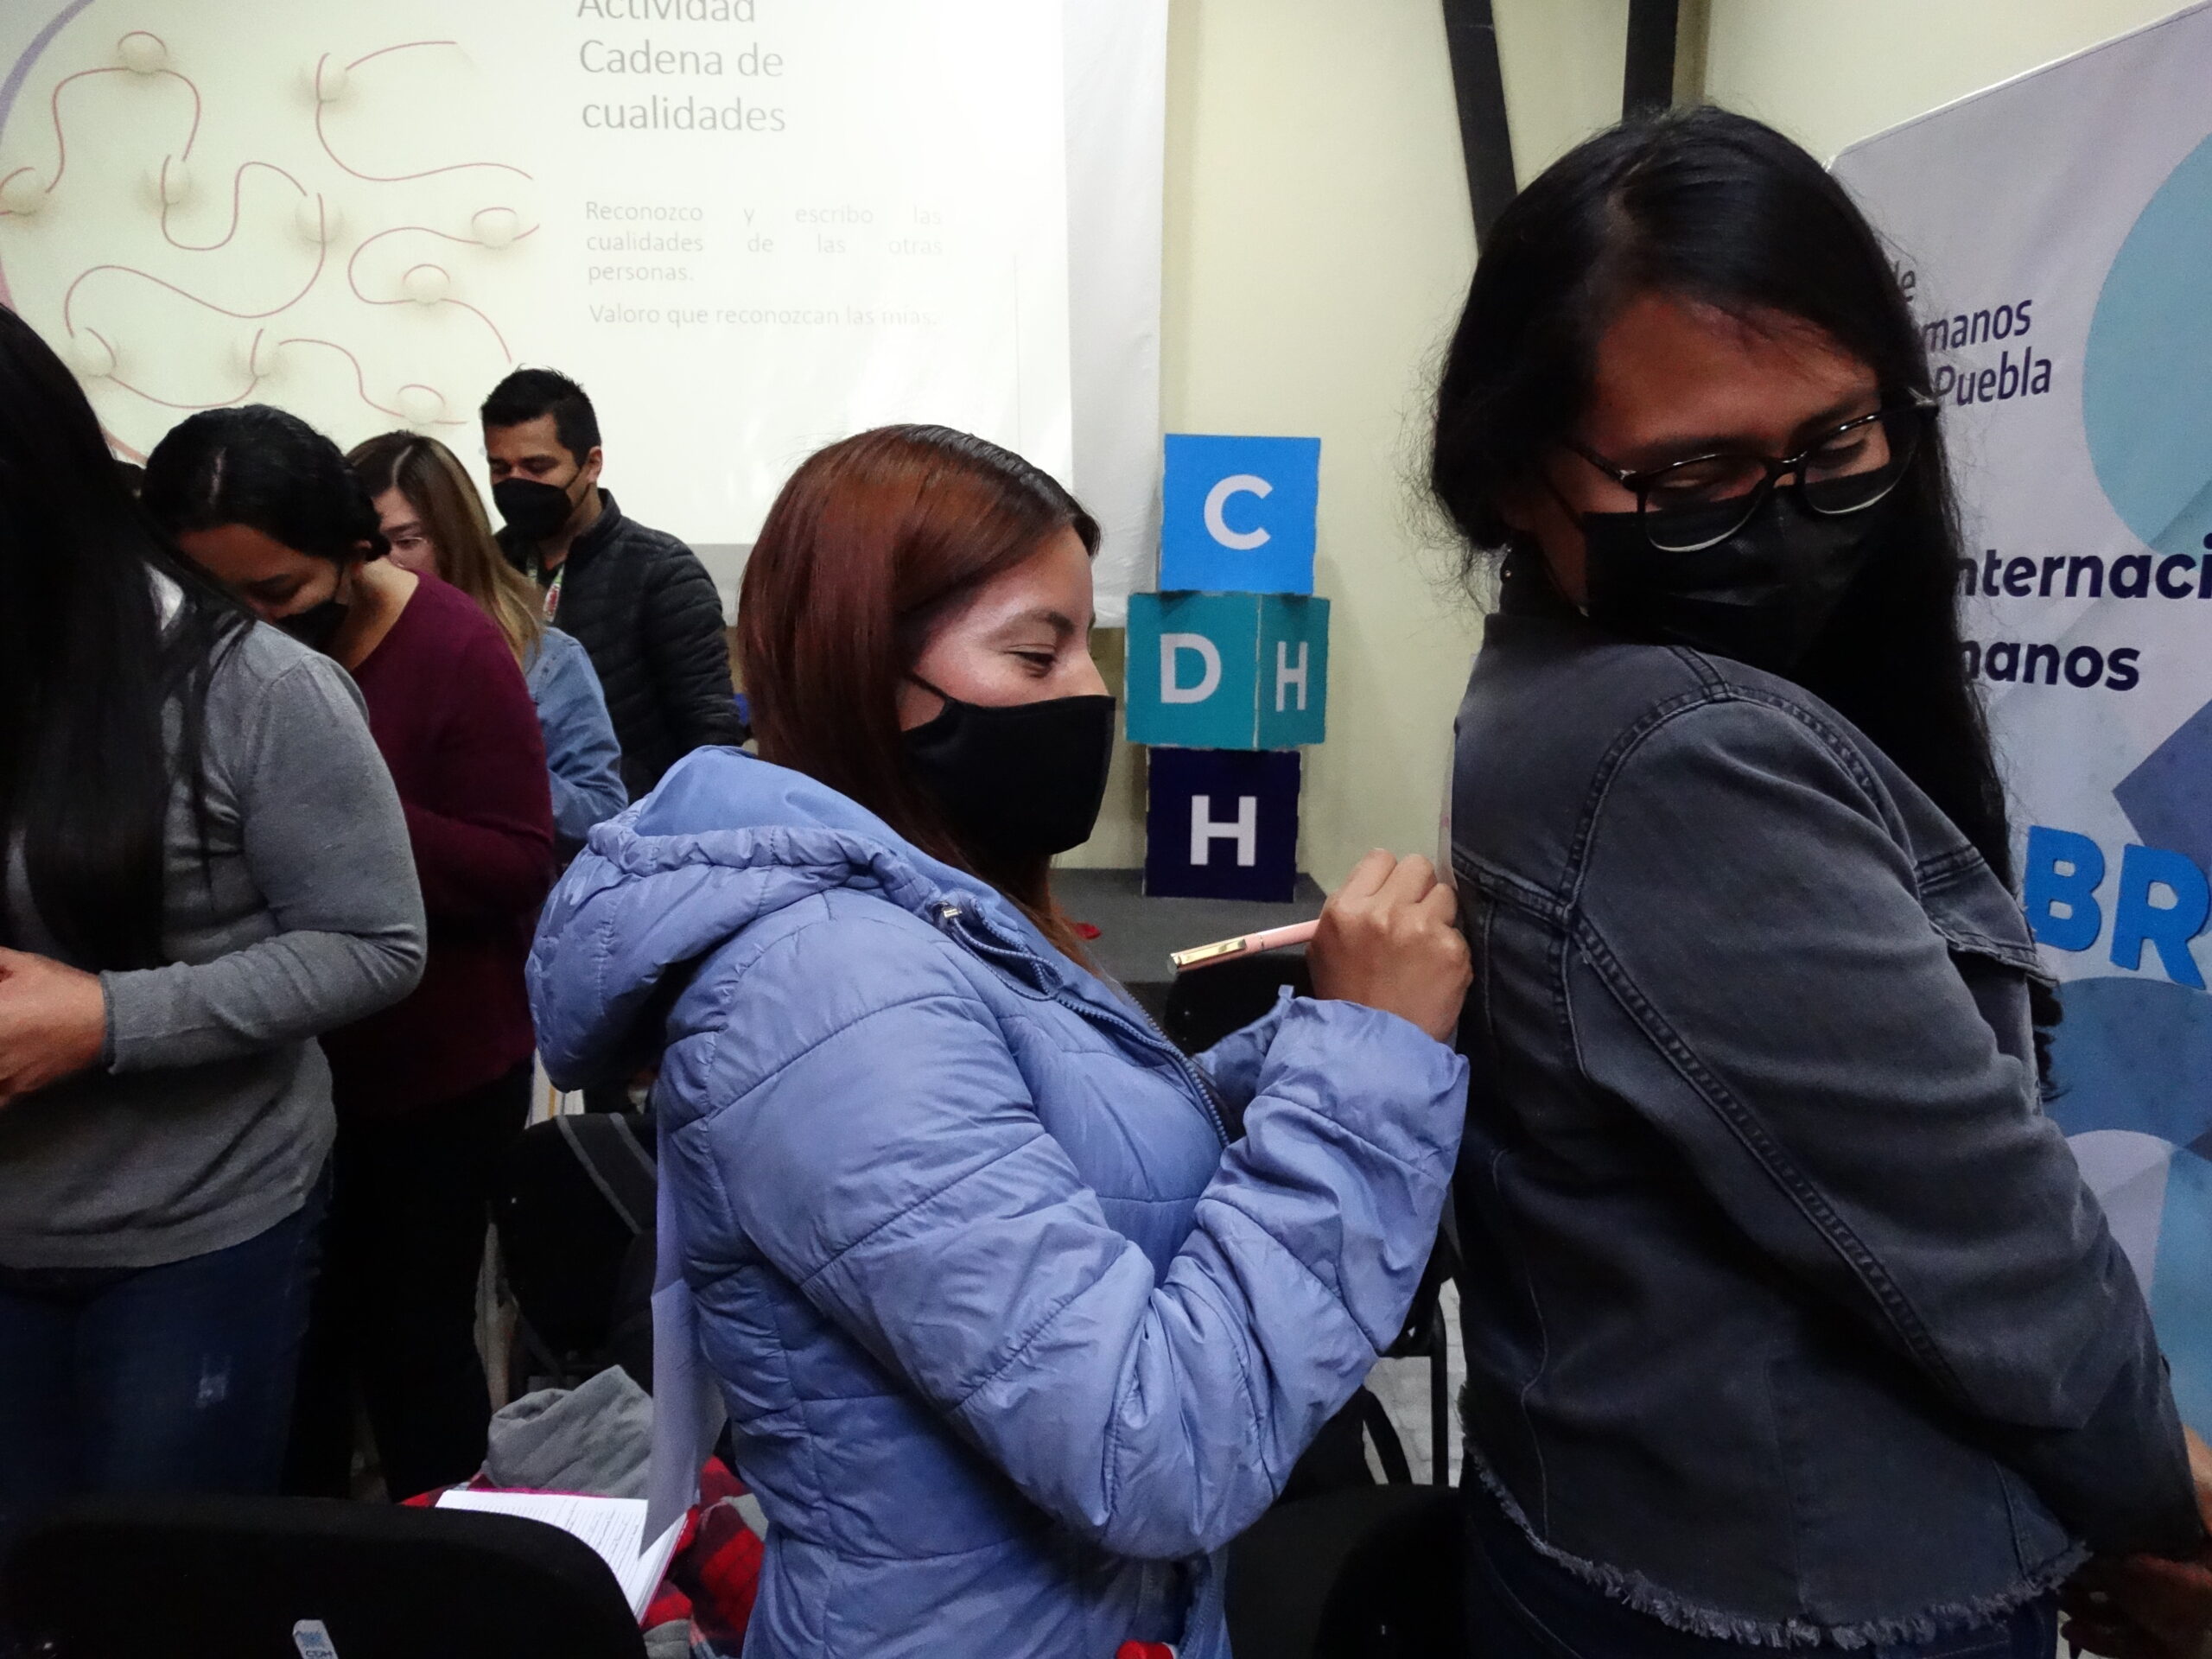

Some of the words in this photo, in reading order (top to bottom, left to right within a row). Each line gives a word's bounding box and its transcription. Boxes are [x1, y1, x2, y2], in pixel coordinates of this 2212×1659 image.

[577, 0, 754, 22] Actividad
[579, 39, 722, 76] Cadena
[738, 41, 783, 76] de
[582, 95, 785, 131] cualidades
[586, 200, 703, 221] Reconozco
[743, 207, 755, 226] y
[795, 204, 874, 224] escribo
[913, 204, 941, 225] las
[586, 231, 704, 252] cualidades
[747, 232, 774, 252] de
[817, 233, 846, 254] las
[888, 238, 943, 256] otras
[588, 264, 694, 285] personas.
[589, 302, 660, 323] Valoro
[667, 308, 709, 329] que
[716, 308, 839, 325] reconozcan
[847, 304, 875, 325] las
[1934, 346, 2052, 406] Puebla
[1204, 474, 1274, 550] C
[1160, 632, 1222, 704] D
[1275, 640, 1309, 712] H
[1190, 794, 1257, 867] H
